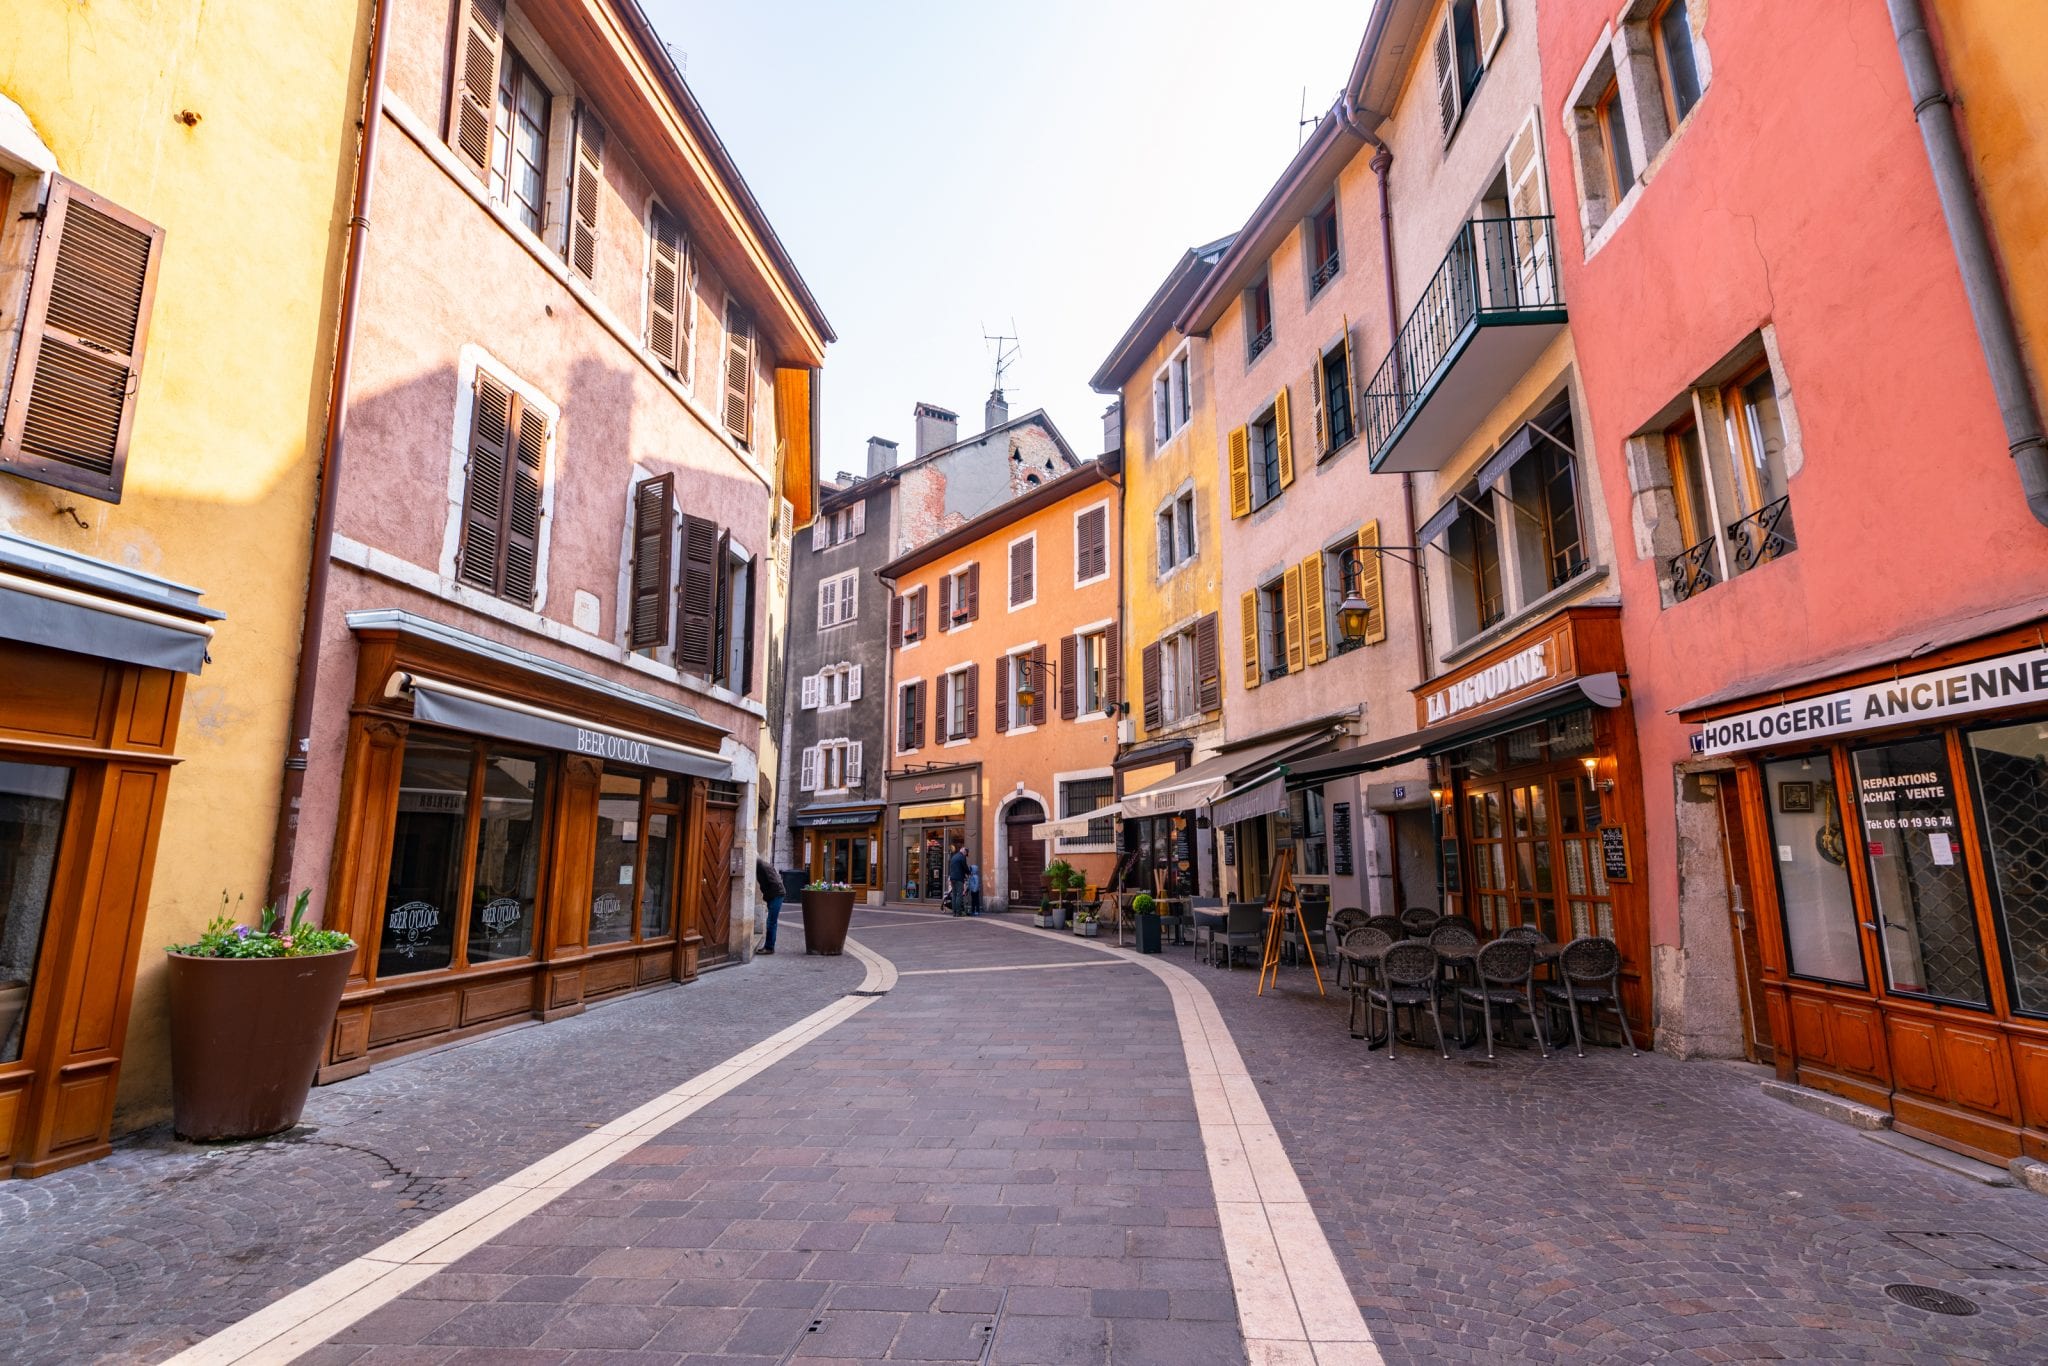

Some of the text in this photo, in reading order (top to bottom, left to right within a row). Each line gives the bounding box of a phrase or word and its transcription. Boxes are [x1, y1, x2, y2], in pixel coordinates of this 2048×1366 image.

[1426, 644, 1547, 723] LA BIGOUDINE
[1705, 699, 1852, 749] HORLOGERIE
[577, 728, 650, 765] BEER O'CLOCK
[1862, 772, 1938, 789] REPARATIONS
[1395, 788, 1403, 798] 15
[1863, 786, 1945, 803] ACHAT VENTE
[1884, 819, 1896, 829] 06
[1898, 818, 1909, 828] 10
[1911, 818, 1922, 828] 19
[1925, 817, 1938, 827] 96
[1940, 816, 1952, 826] 74
[389, 911, 408, 929] BEER
